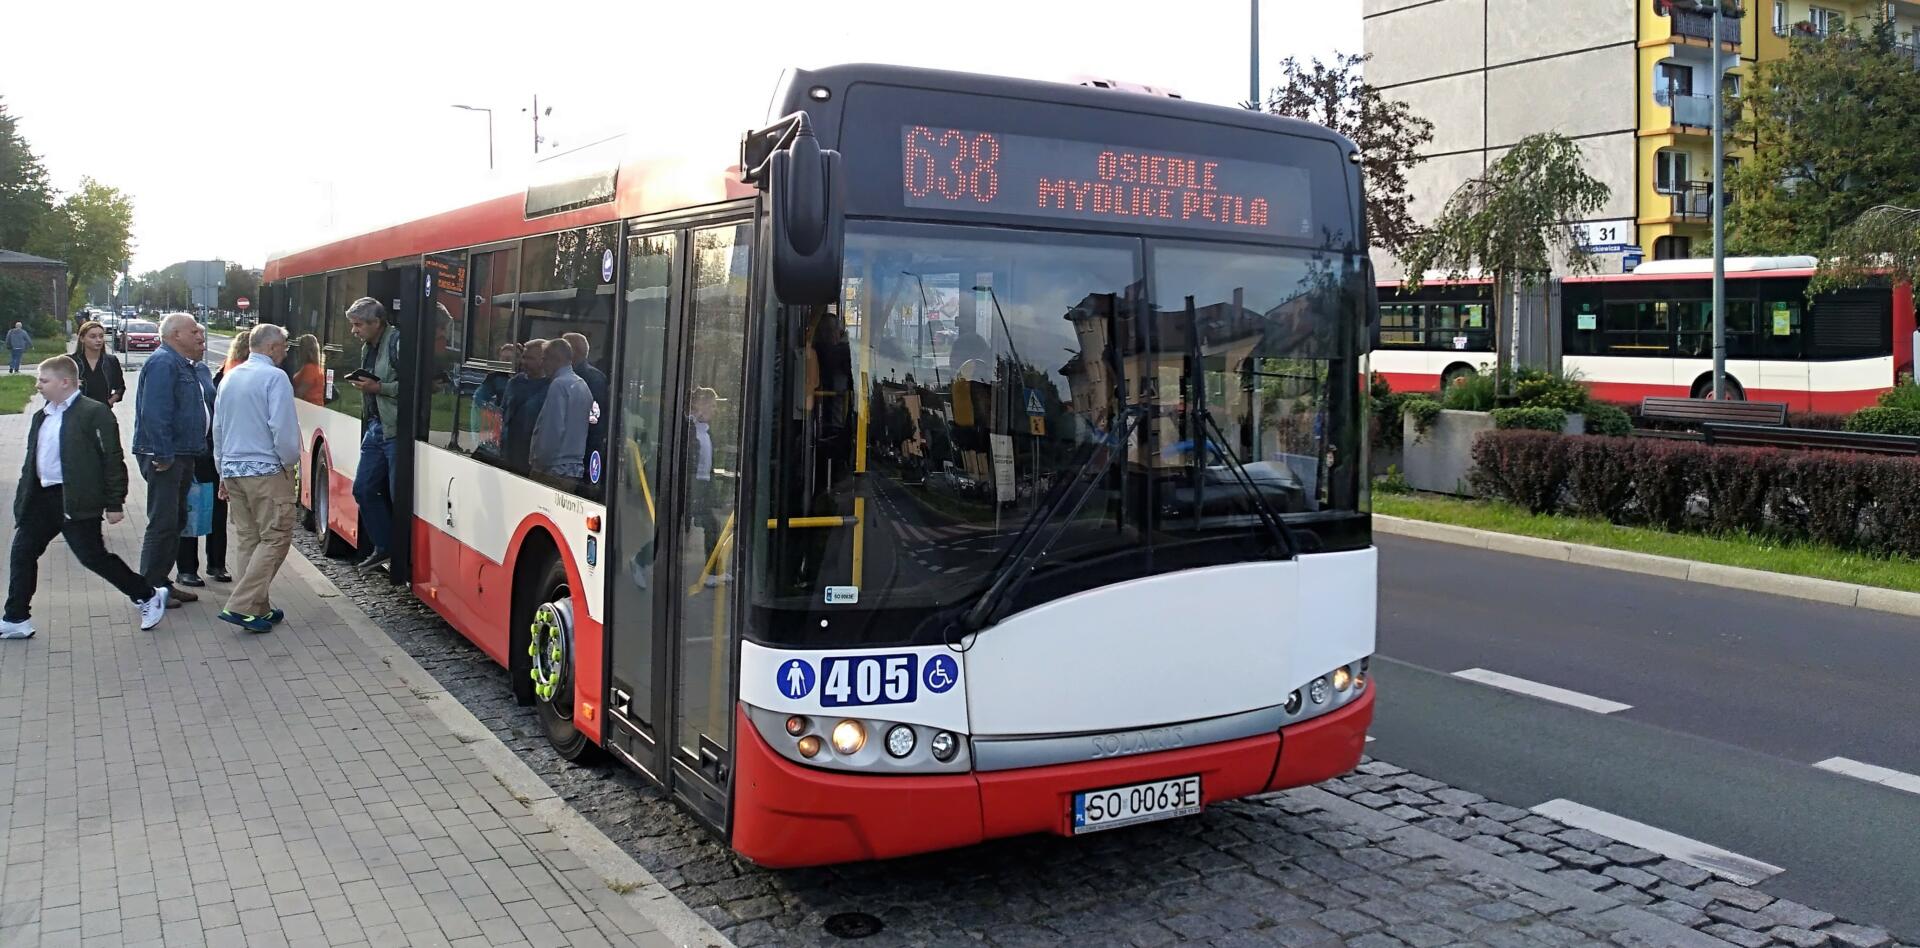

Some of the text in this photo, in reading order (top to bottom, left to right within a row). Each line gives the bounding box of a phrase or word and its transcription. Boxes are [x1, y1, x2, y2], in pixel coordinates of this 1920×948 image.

[905, 125, 1000, 203] 638
[1098, 151, 1218, 190] OSIEDLE
[1039, 178, 1174, 218] MYDLICE
[1599, 227, 1616, 241] 31
[825, 657, 909, 703] 405
[1091, 726, 1184, 758] SOLARIS
[1088, 780, 1196, 821] SO 0063E
